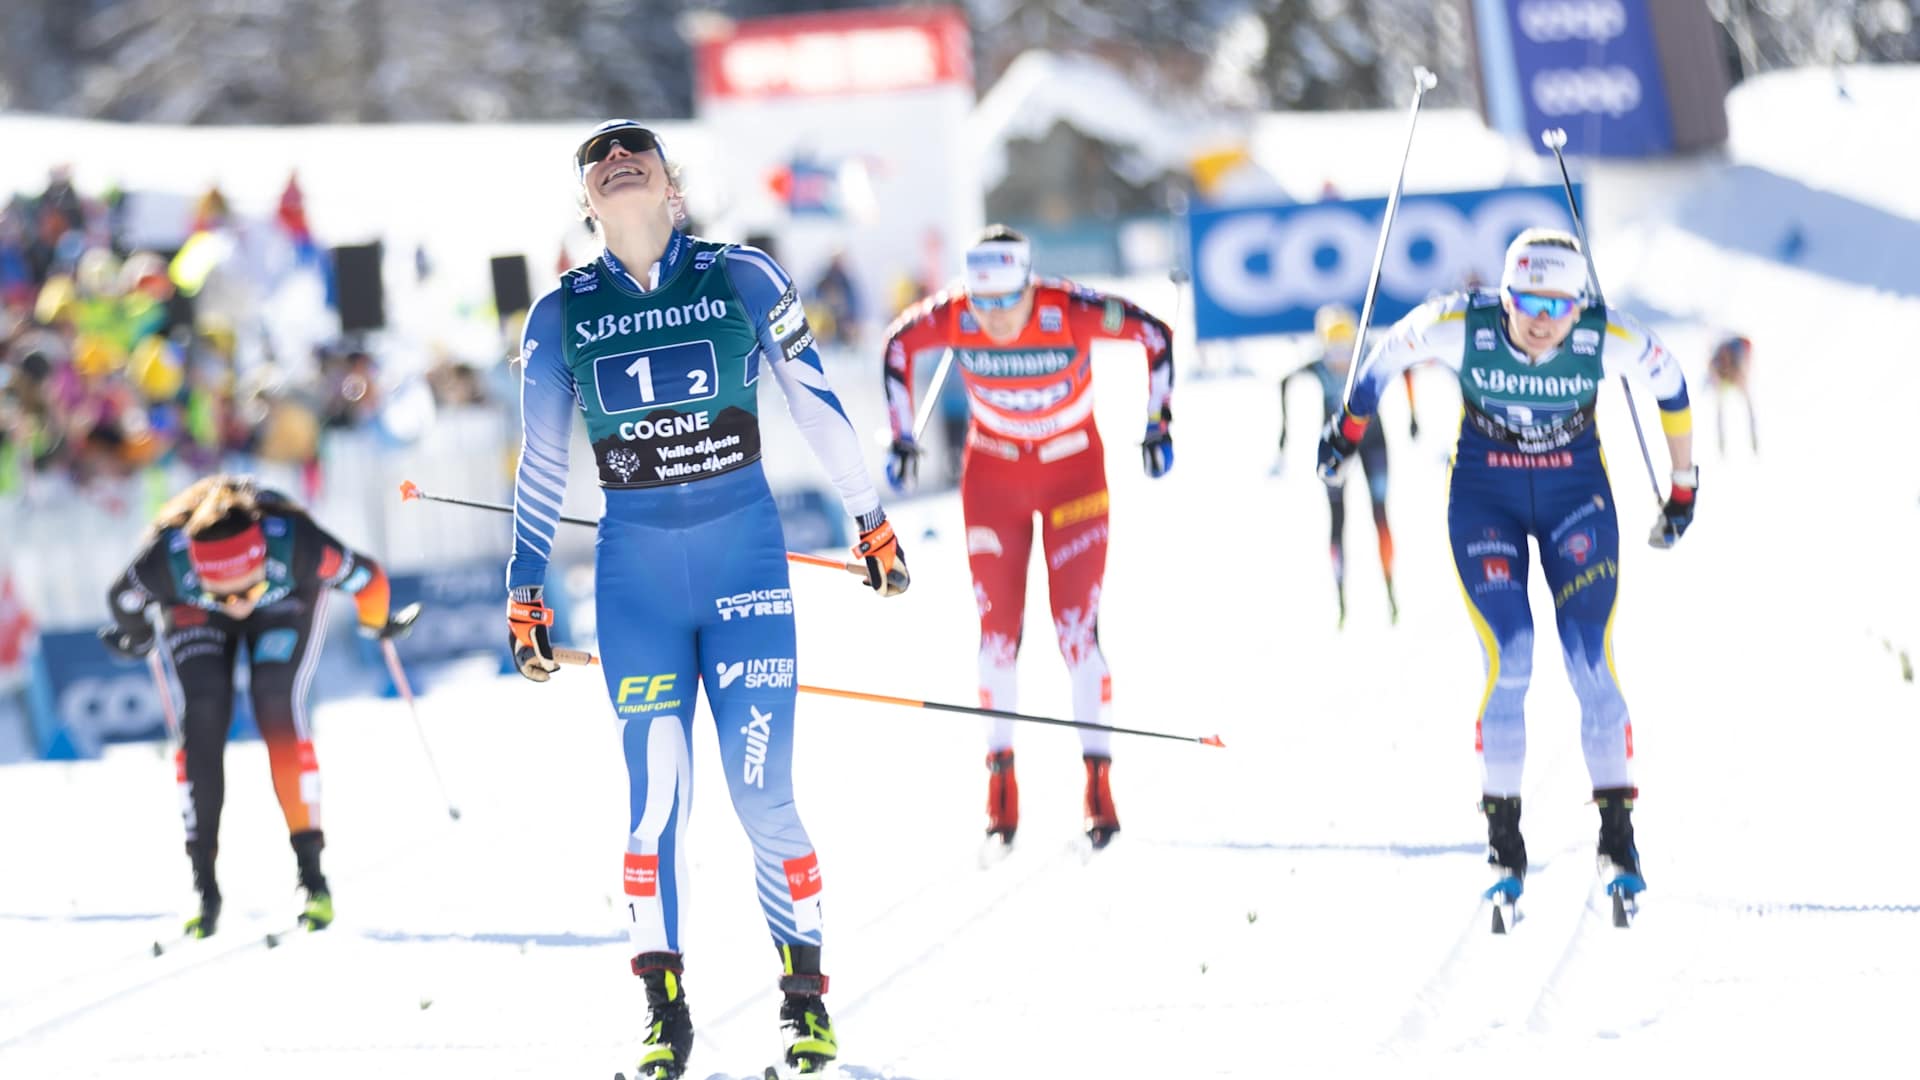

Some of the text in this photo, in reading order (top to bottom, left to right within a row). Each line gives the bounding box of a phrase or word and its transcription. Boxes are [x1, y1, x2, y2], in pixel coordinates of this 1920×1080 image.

[575, 296, 728, 349] S.Bernardo
[624, 356, 709, 403] 1 2
[619, 410, 710, 441] COGNE
[656, 445, 694, 462] Valle
[719, 600, 793, 621] TYRES
[617, 673, 677, 704] FF
[745, 673, 793, 688] SPORT
[628, 902, 637, 923] 1
